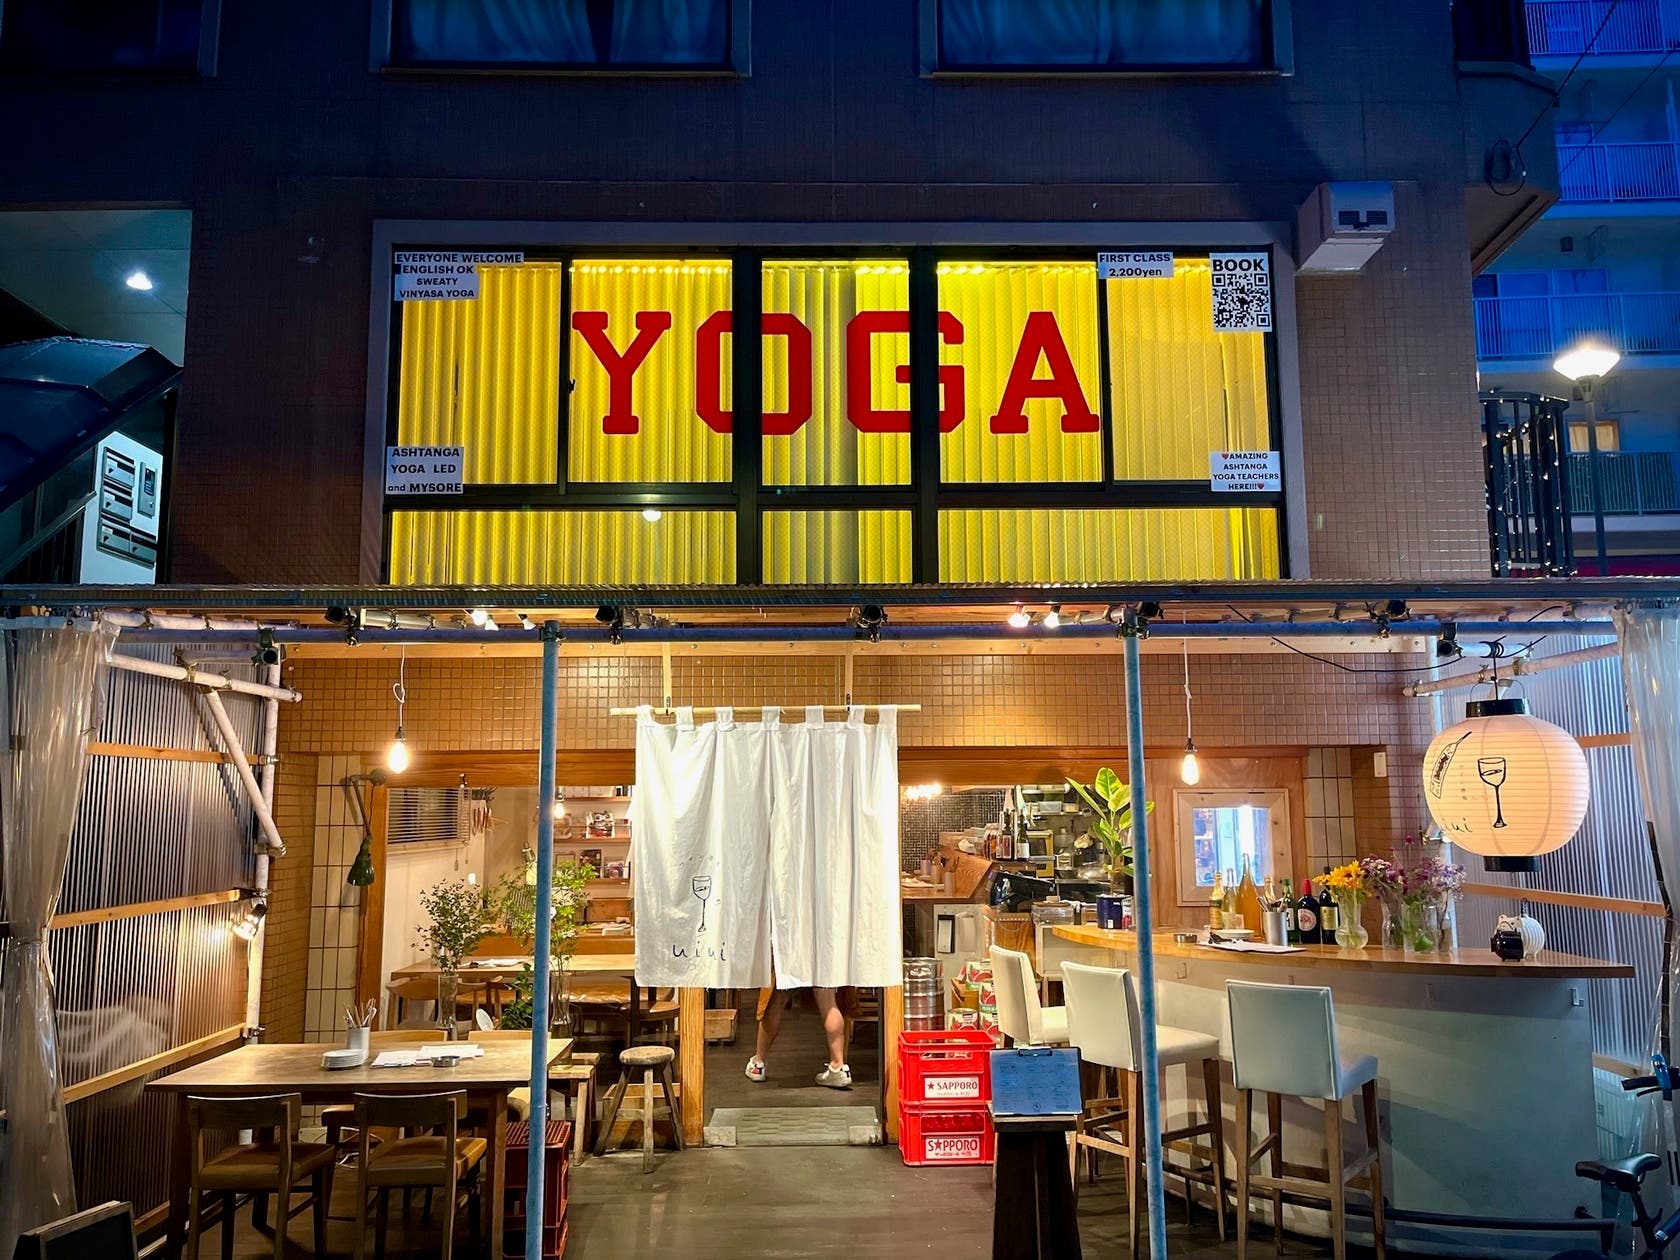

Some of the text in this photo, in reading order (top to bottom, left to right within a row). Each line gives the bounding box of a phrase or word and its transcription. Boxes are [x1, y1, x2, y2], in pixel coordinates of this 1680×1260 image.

[396, 253, 521, 263] EVERYONE WELCOME
[1099, 253, 1170, 263] FIRST CLASS
[403, 265, 473, 274] ENGLISH OK
[1213, 259, 1264, 271] BOOK
[1110, 268, 1162, 277] 2,200yen
[400, 290, 444, 298] VINYASA
[572, 311, 1100, 435] YOGA
[392, 448, 460, 457] ASHTANGA
[391, 464, 456, 474] YOGA LED
[388, 483, 462, 492] and MYSORE
[937, 1081, 978, 1090] SAPPORO
